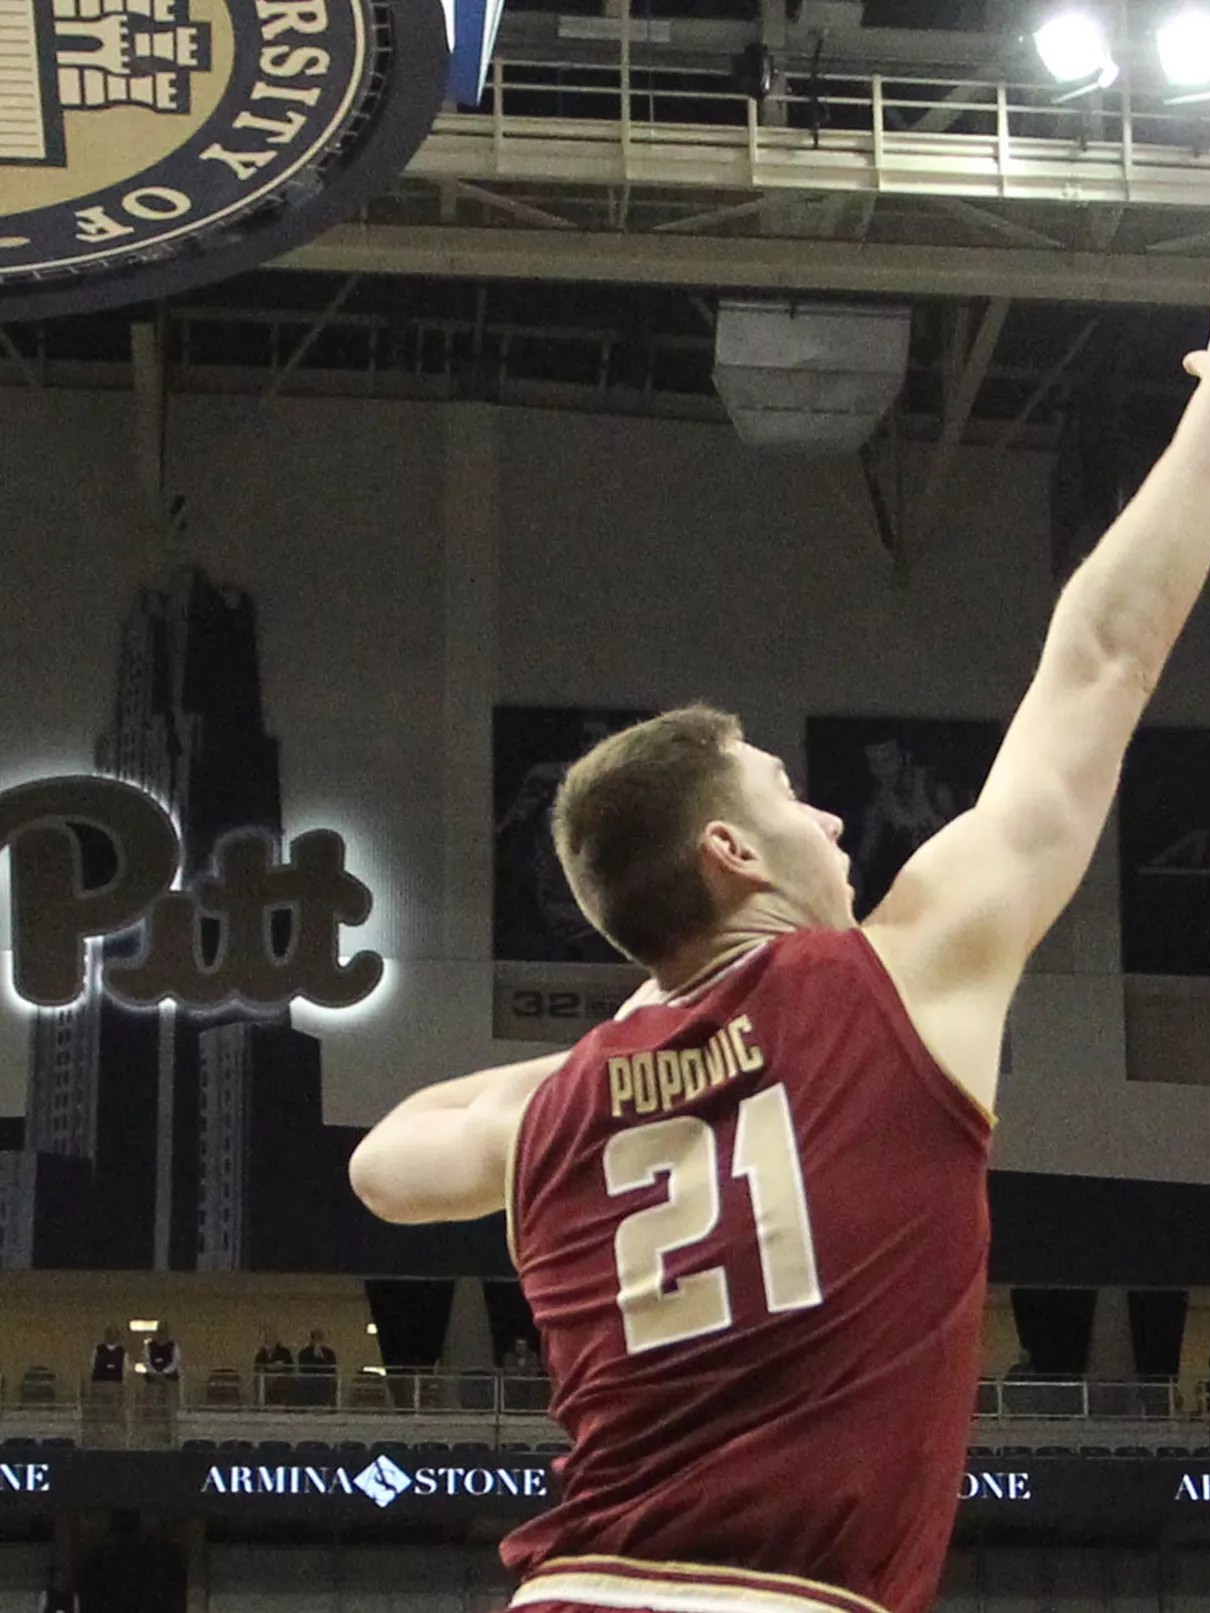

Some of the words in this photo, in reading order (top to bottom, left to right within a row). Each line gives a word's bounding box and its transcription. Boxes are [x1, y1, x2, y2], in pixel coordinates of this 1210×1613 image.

[75, 185, 192, 244] OF
[0, 774, 385, 1009] Pitt
[511, 990, 581, 1019] 32
[607, 1014, 766, 1118] POPOVIC
[603, 1082, 823, 1355] 21
[200, 1465, 355, 1495] ARMINA
[414, 1467, 548, 1497] STONE
